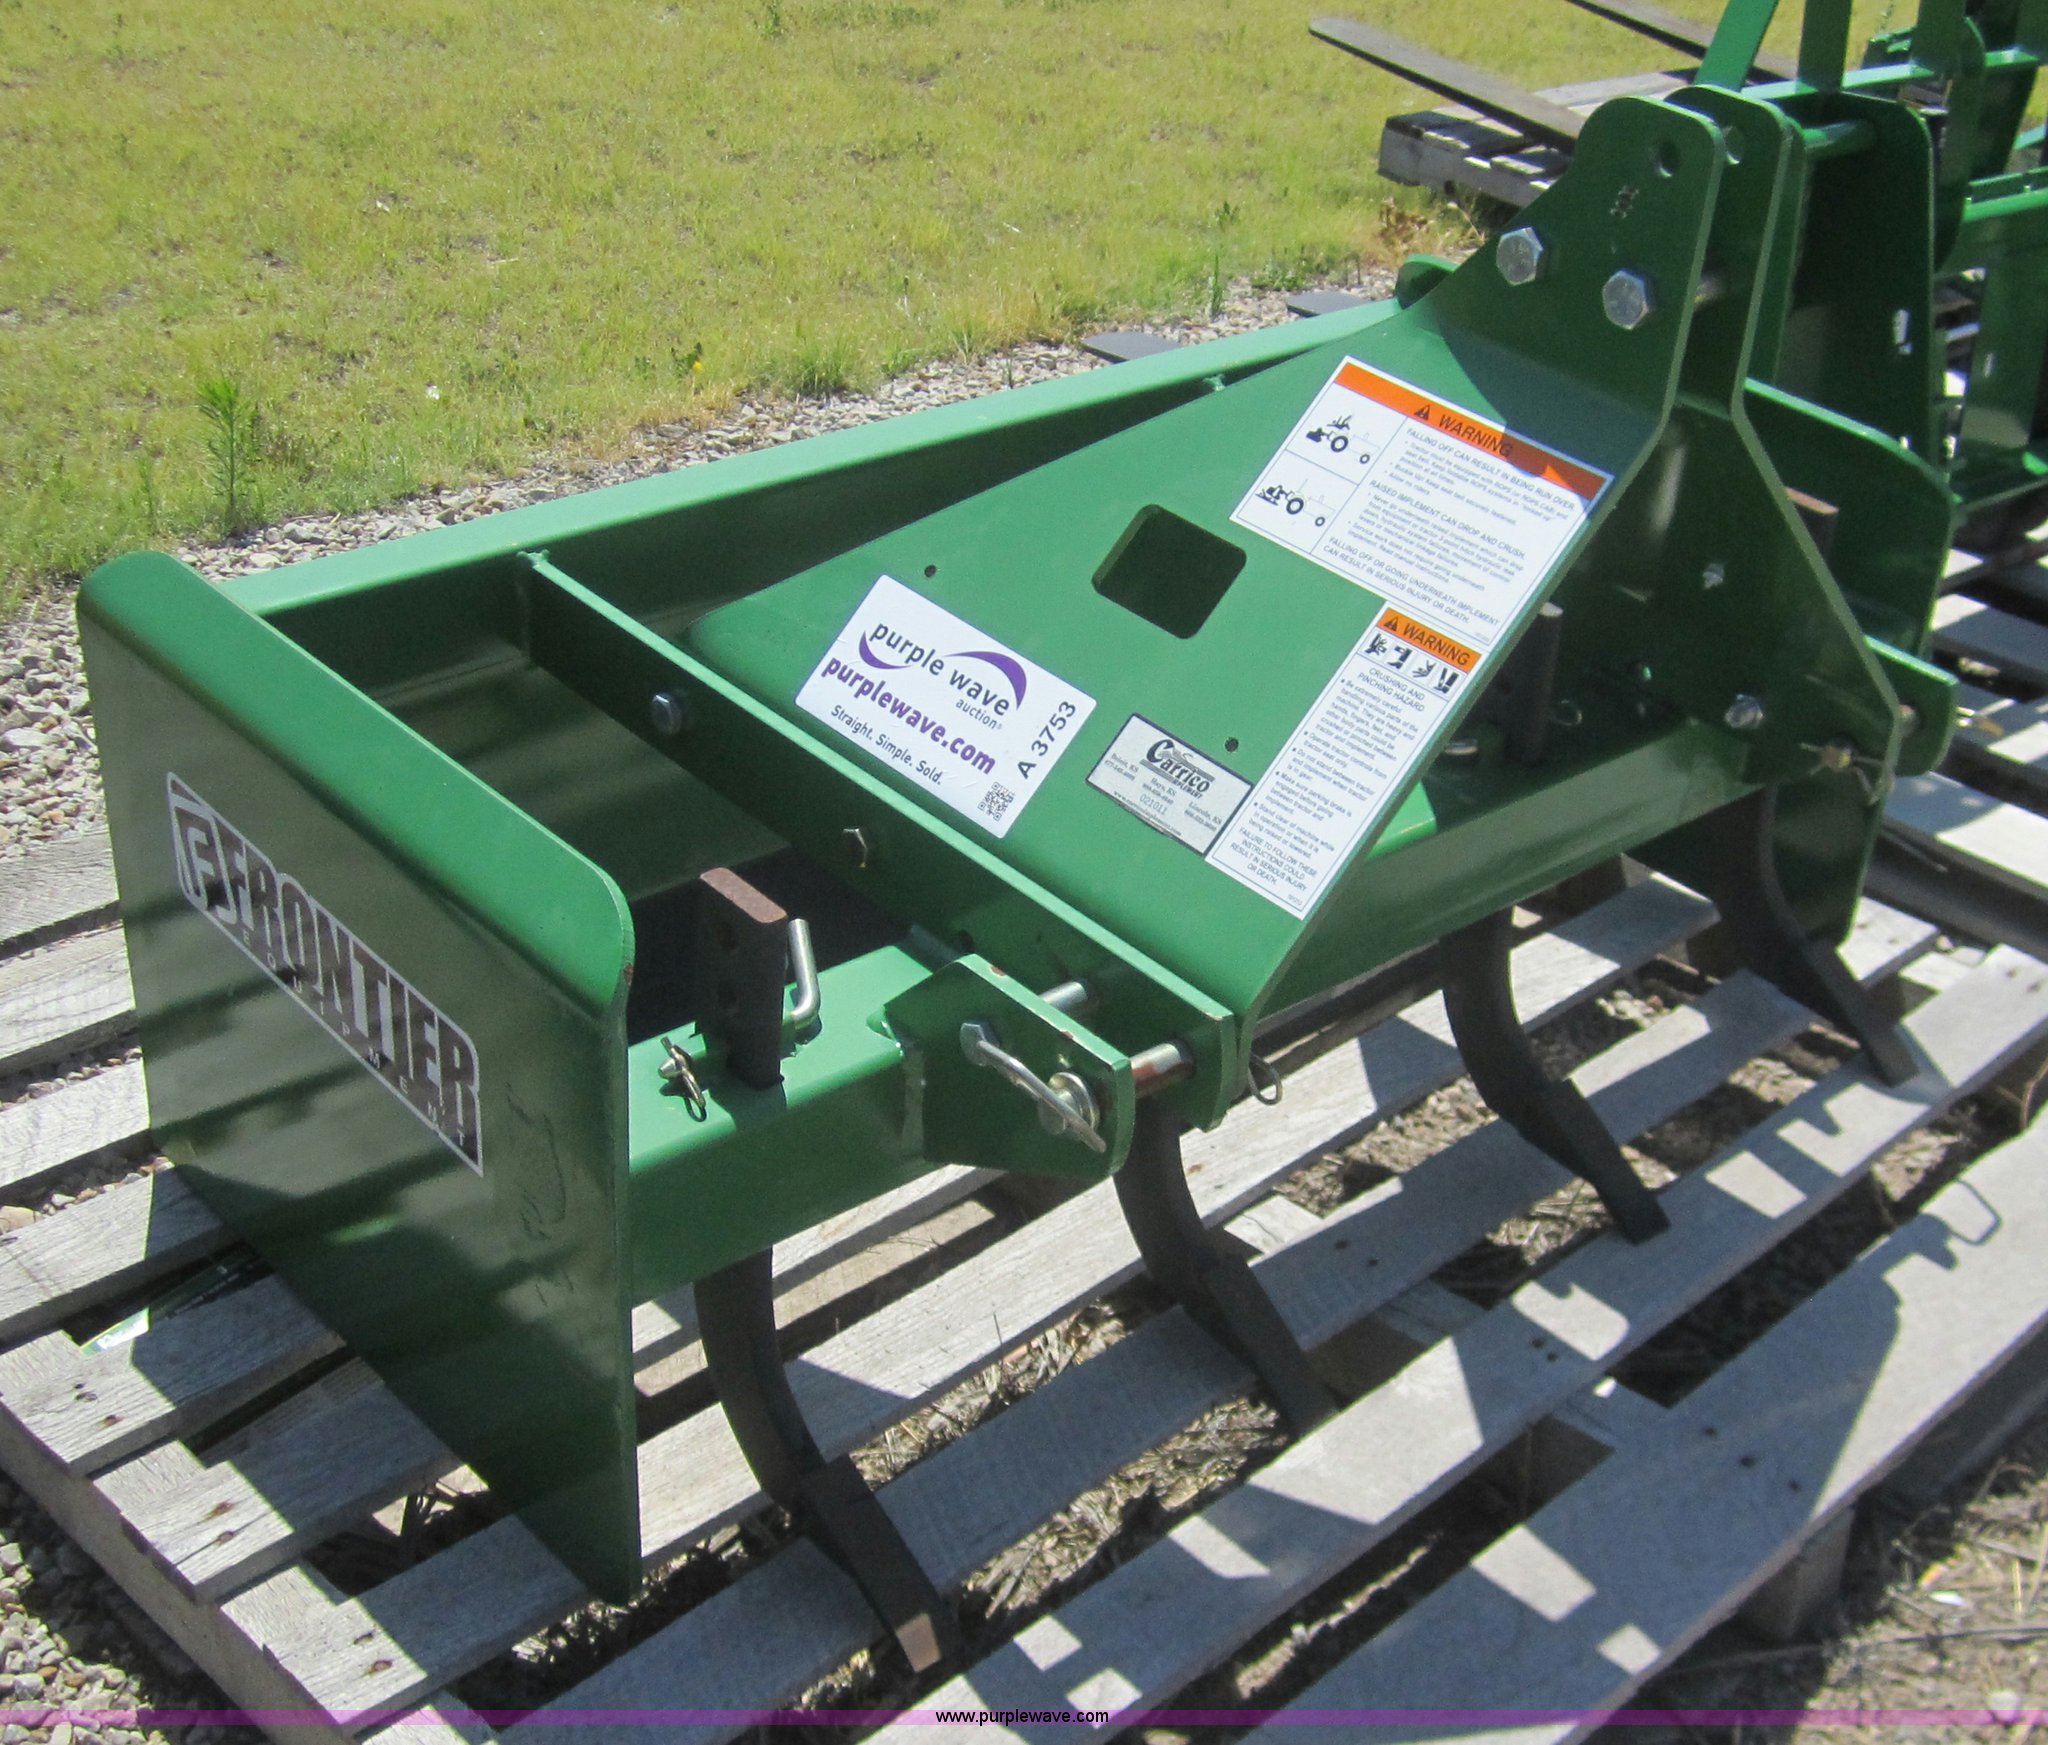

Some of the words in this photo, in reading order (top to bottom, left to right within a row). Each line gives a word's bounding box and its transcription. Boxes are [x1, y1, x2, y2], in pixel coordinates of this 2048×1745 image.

[1406, 428, 1438, 447] FALLING
[1437, 442, 1454, 453] OFF
[1453, 450, 1471, 462] CAN
[1470, 457, 1501, 475] RESULT
[1500, 472, 1510, 480] IN
[1509, 476, 1535, 492] BEING
[1534, 487, 1553, 500] RUN
[1439, 414, 1513, 458] WARNING
[1369, 479, 1398, 497] RAISED
[1396, 493, 1441, 517] IMPLEMENT
[1440, 513, 1458, 526] CAN
[1457, 521, 1480, 536] DROP
[1479, 533, 1498, 545] AND
[1322, 545, 1339, 556] CAN
[1338, 552, 1367, 570] RESULT
[1365, 566, 1374, 574] IN
[1374, 570, 1406, 591] SERIOUS
[1405, 587, 1432, 603] INJURY
[1432, 600, 1445, 610] OR
[1328, 536, 1359, 555] FALLING
[1358, 551, 1373, 562] OFF
[1372, 559, 1385, 568] OR
[1384, 564, 1409, 581] GOING
[1408, 577, 1458, 605] UNDERNEATH
[1456, 601, 1499, 626] IMPLEMENT
[868, 622, 945, 676] purple
[949, 669, 1010, 716] wave
[1402, 623, 1471, 666] WARNING
[1357, 672, 1394, 695] PINCHING
[1392, 691, 1425, 712] HAZARD
[1368, 667, 1408, 692] CRUSHING
[1407, 688, 1425, 701] AND
[821, 657, 996, 775] purplewave.com
[830, 704, 874, 741] Straight.
[875, 733, 913, 767] Simple.
[915, 760, 943, 785] Sold.
[1017, 761, 1037, 780] A
[1031, 701, 1076, 757] 3753
[1146, 739, 1210, 793] Carrico
[1139, 793, 1168, 816] 021011
[1229, 842, 1254, 859] RESULT
[1259, 860, 1286, 879] SERIOUS
[1284, 875, 1307, 891] INJURY
[1238, 826, 1264, 845] FAILURE
[1263, 841, 1273, 851] TO
[1271, 846, 1298, 865] FOLLOW
[1297, 861, 1317, 877] THESE
[1241, 839, 1284, 867] INSTRUCTIONS
[1283, 863, 1305, 880] COULD
[1246, 862, 1258, 872] OR
[215, 820, 476, 1126] FRONTIER
[243, 930, 464, 1145] EQUIPMENT
